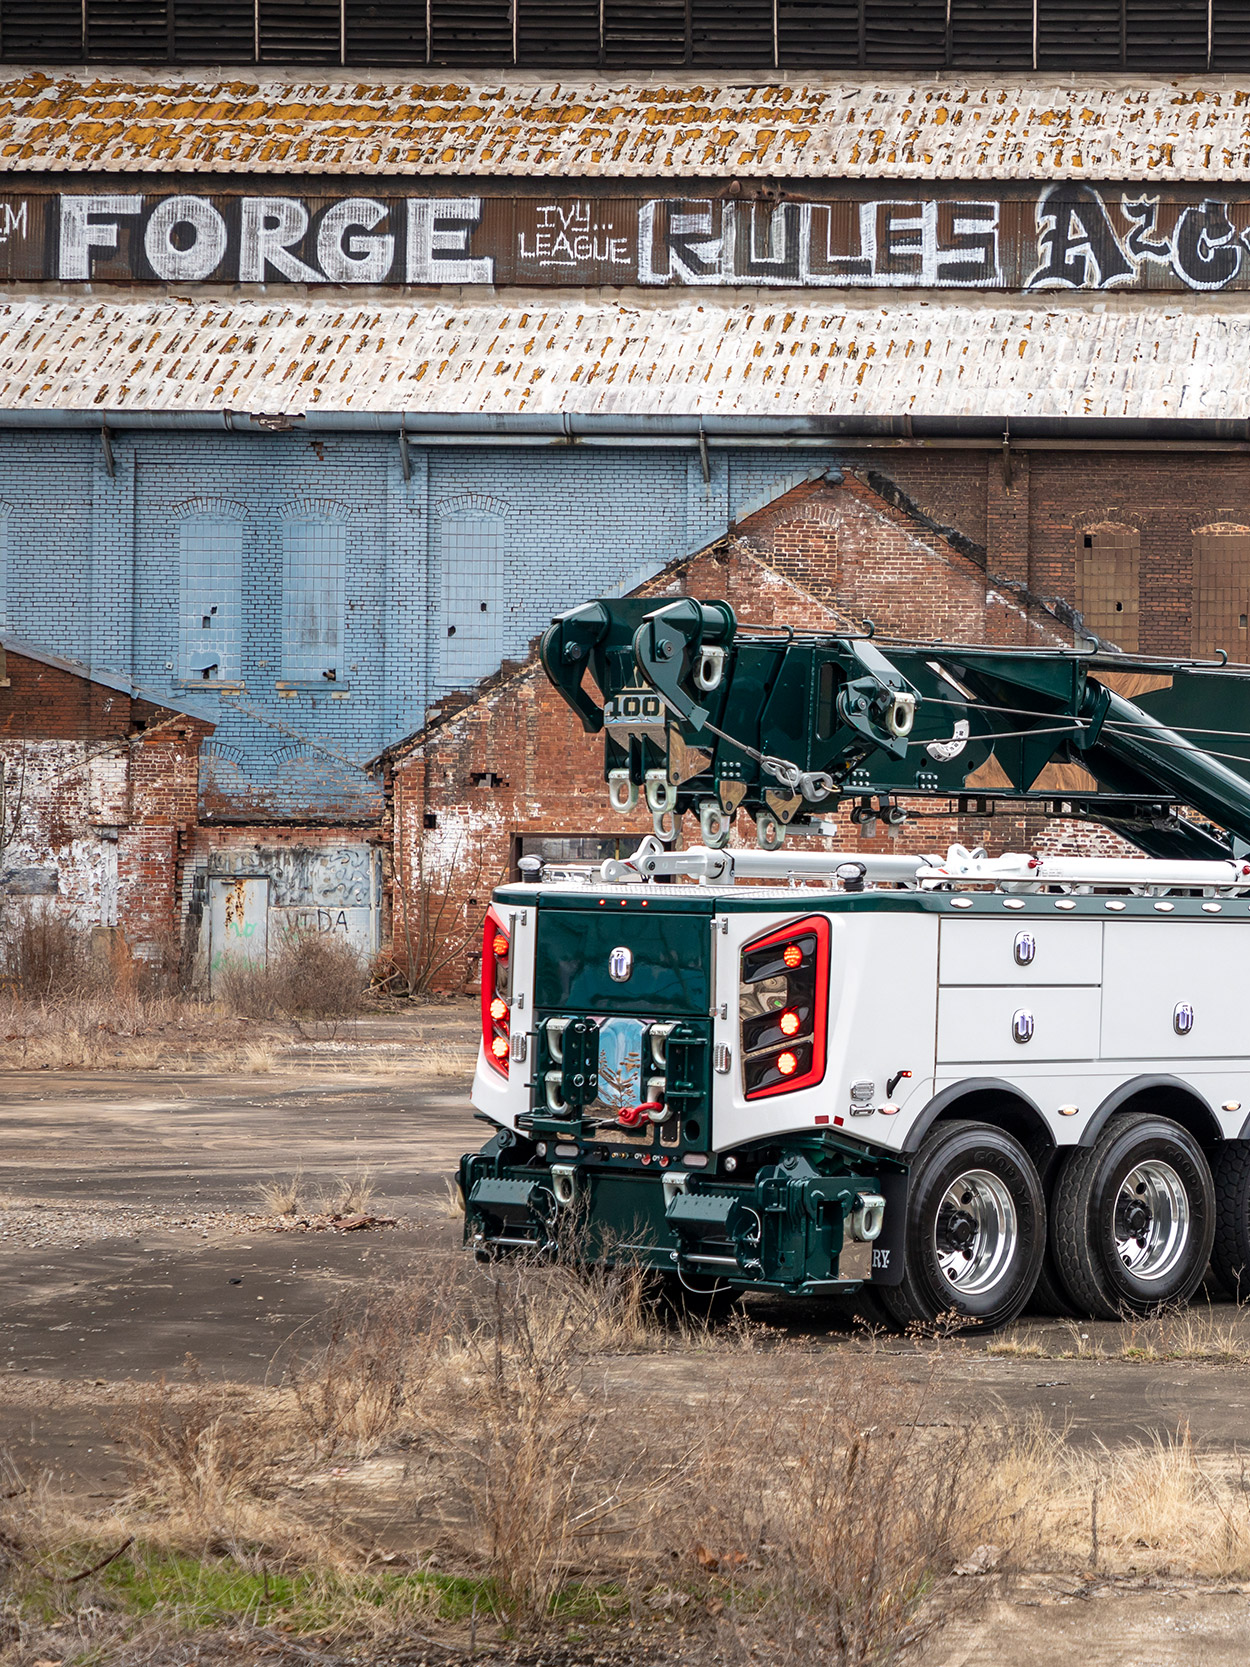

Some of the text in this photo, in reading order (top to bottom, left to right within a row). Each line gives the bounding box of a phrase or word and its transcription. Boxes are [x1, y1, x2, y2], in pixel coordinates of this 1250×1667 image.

[58, 193, 495, 284] FORGE
[518, 231, 631, 263] LEAGUE
[638, 198, 1004, 287] RULES
[609, 697, 660, 717] 100
[872, 1249, 890, 1268] RY
